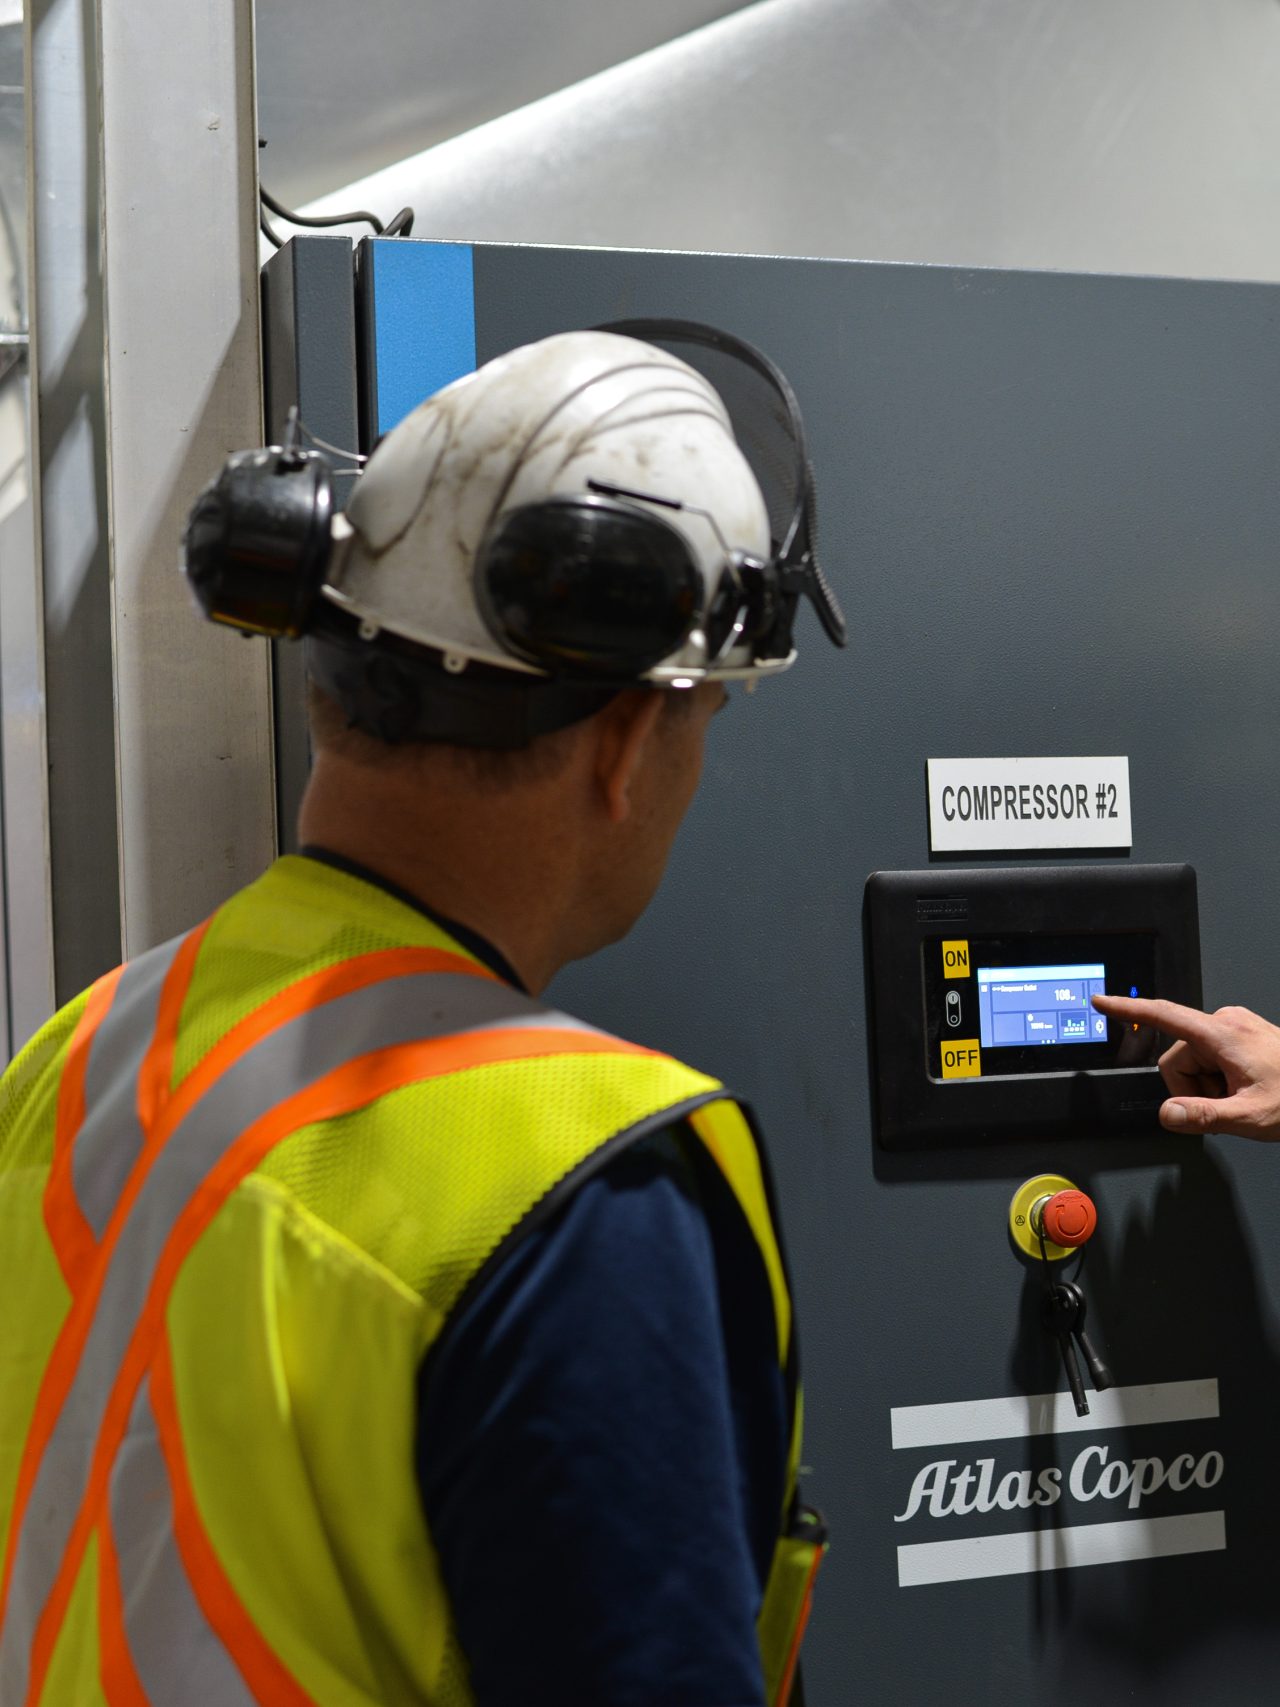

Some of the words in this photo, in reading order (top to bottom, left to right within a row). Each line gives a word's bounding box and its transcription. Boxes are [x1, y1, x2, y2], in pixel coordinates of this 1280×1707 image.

[942, 784, 1090, 821] COMPRESSOR
[1095, 783, 1118, 819] #2
[945, 949, 967, 967] ON
[944, 1049, 978, 1068] OFF
[894, 1458, 1062, 1522] Atlas
[1069, 1446, 1224, 1509] Copco
